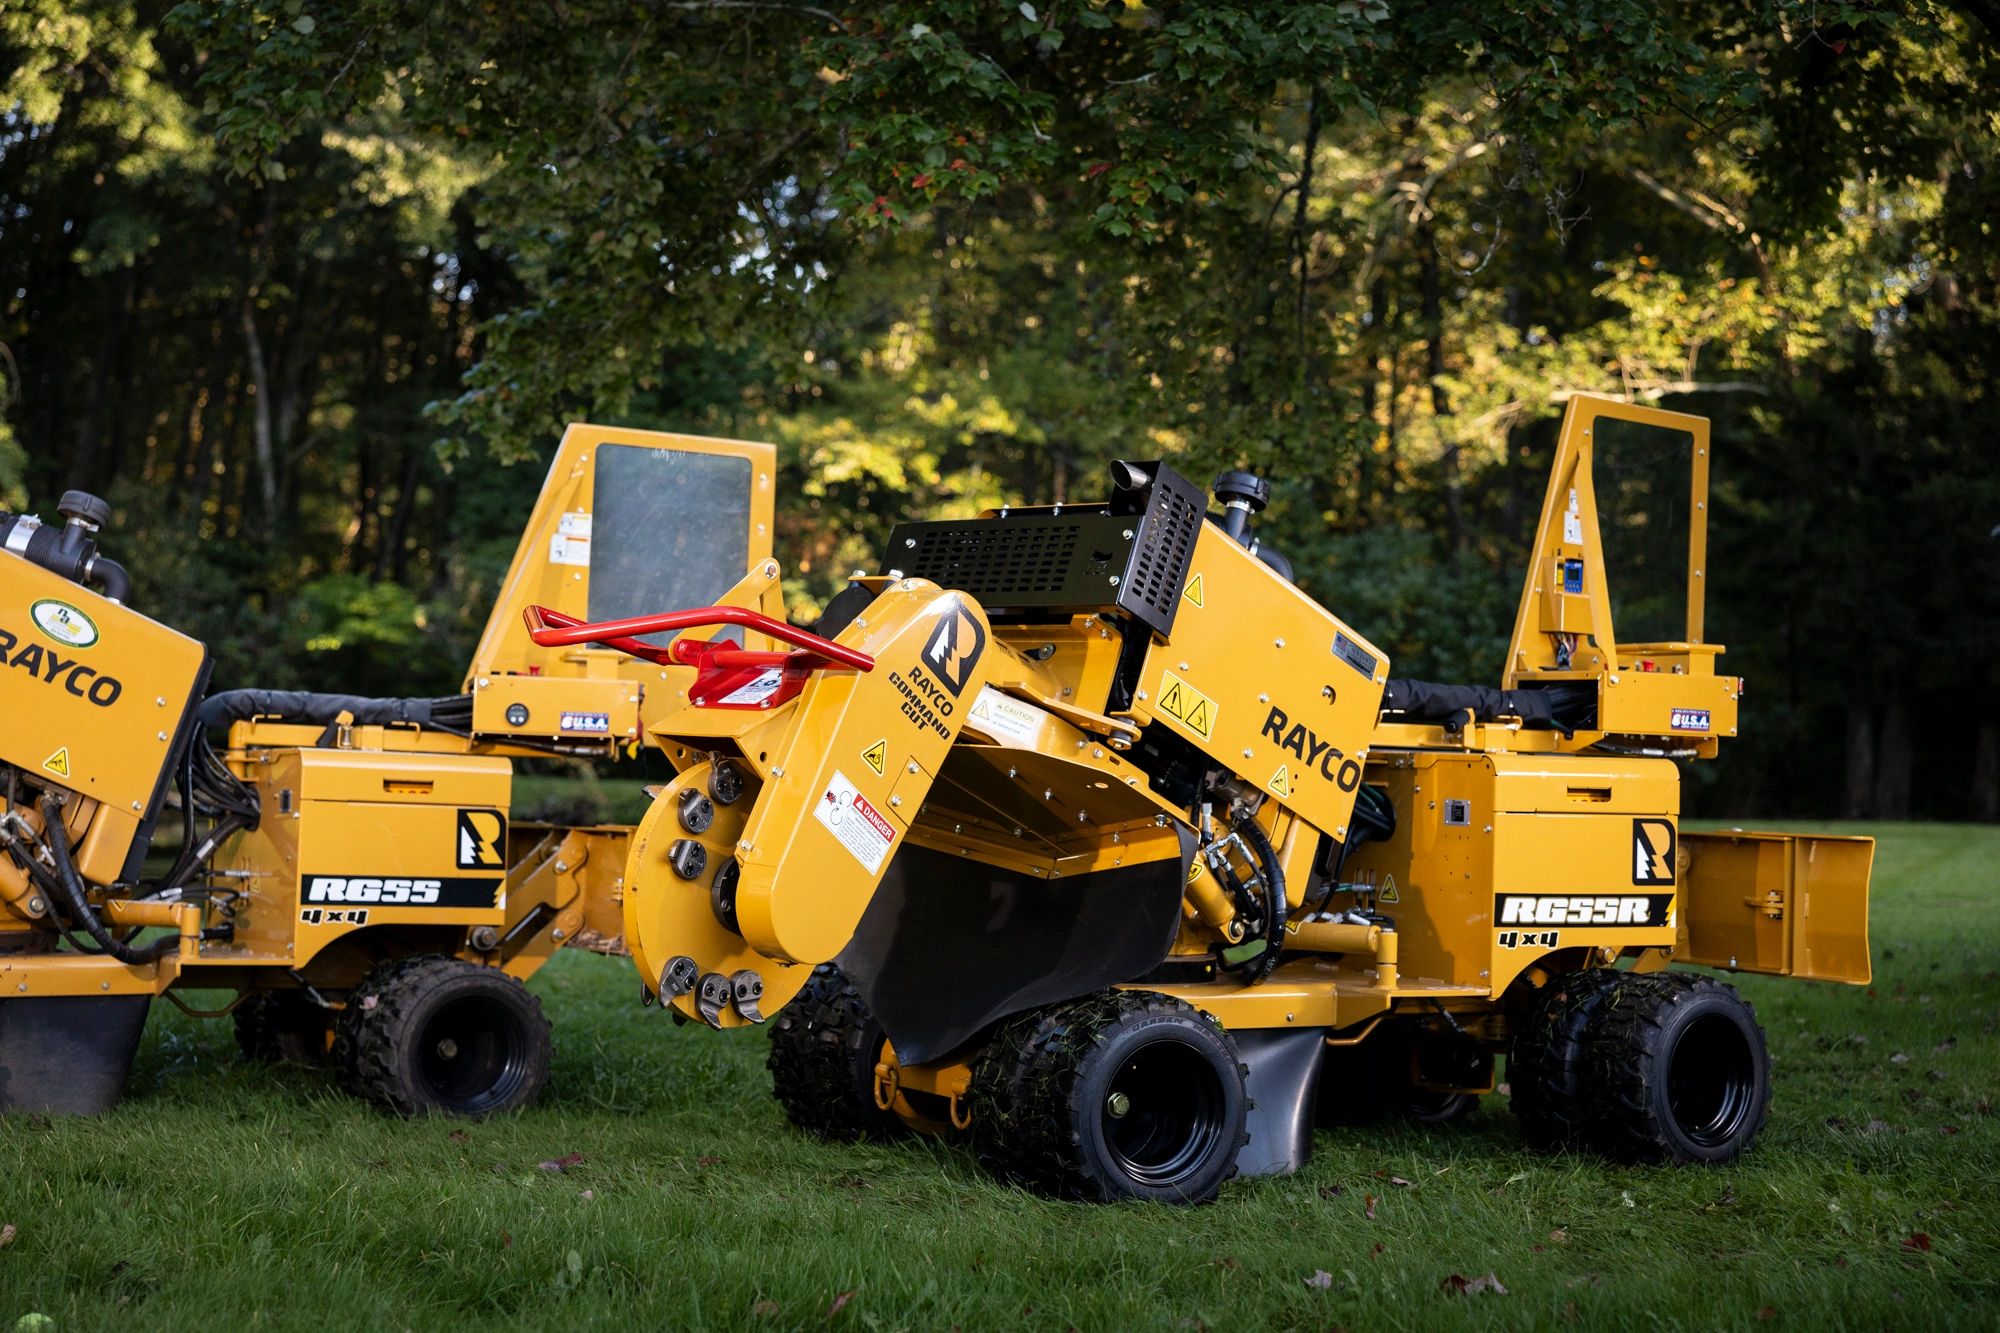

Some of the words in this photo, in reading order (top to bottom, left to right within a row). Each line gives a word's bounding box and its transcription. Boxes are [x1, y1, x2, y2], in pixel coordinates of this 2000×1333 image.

[908, 666, 954, 717] RAYCO
[888, 672, 951, 740] COMMAND
[901, 702, 929, 731] CUT
[1004, 705, 1035, 723] CAUTION
[1261, 706, 1361, 793] RAYCO
[863, 806, 892, 838] DANGER
[308, 877, 442, 903] RG55
[301, 908, 369, 925] 4x4
[1501, 896, 1651, 924] RG55R
[1498, 931, 1559, 948] 4x4
